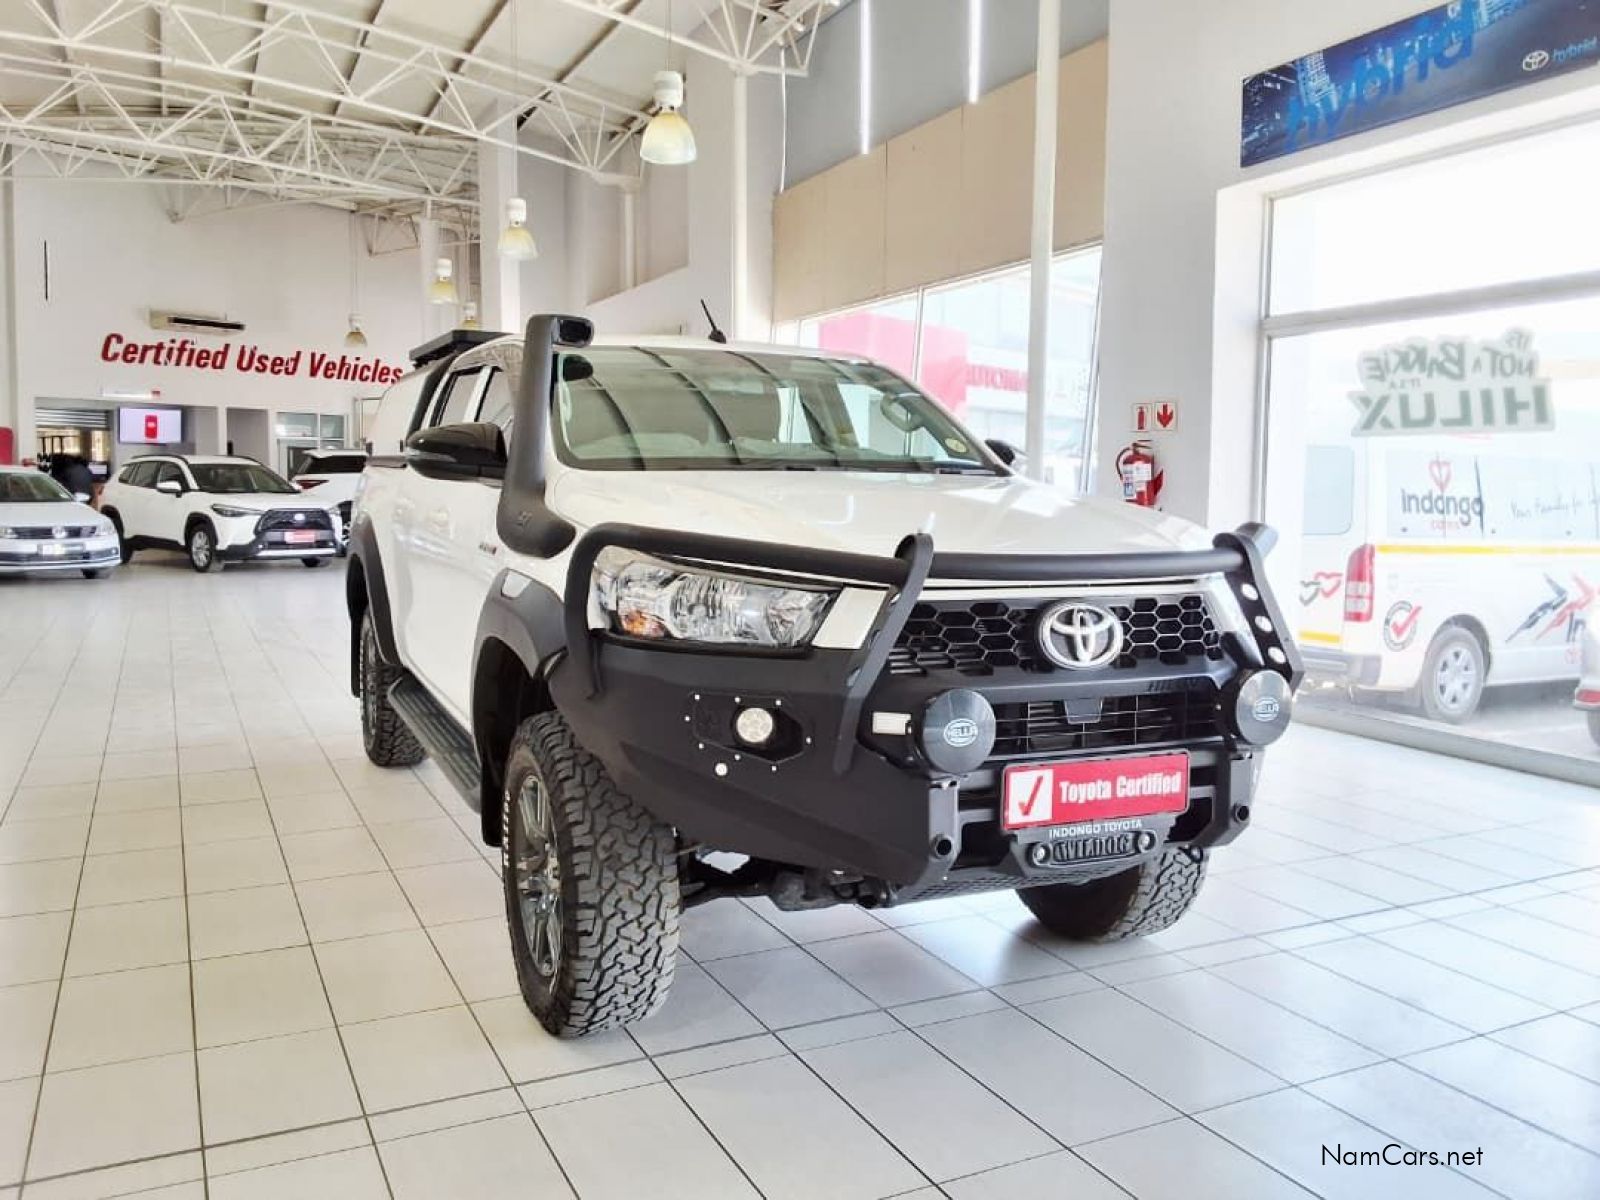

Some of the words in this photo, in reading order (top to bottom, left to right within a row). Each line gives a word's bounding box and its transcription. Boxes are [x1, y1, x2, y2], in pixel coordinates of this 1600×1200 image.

[101, 333, 230, 370] Certified
[236, 345, 302, 376] Used
[309, 352, 403, 384] Vehicles
[1060, 780, 1112, 803] Toyota
[1117, 771, 1183, 798] Certified
[1049, 823, 1100, 840] INDONGO
[1103, 818, 1143, 833] TOYOTA
